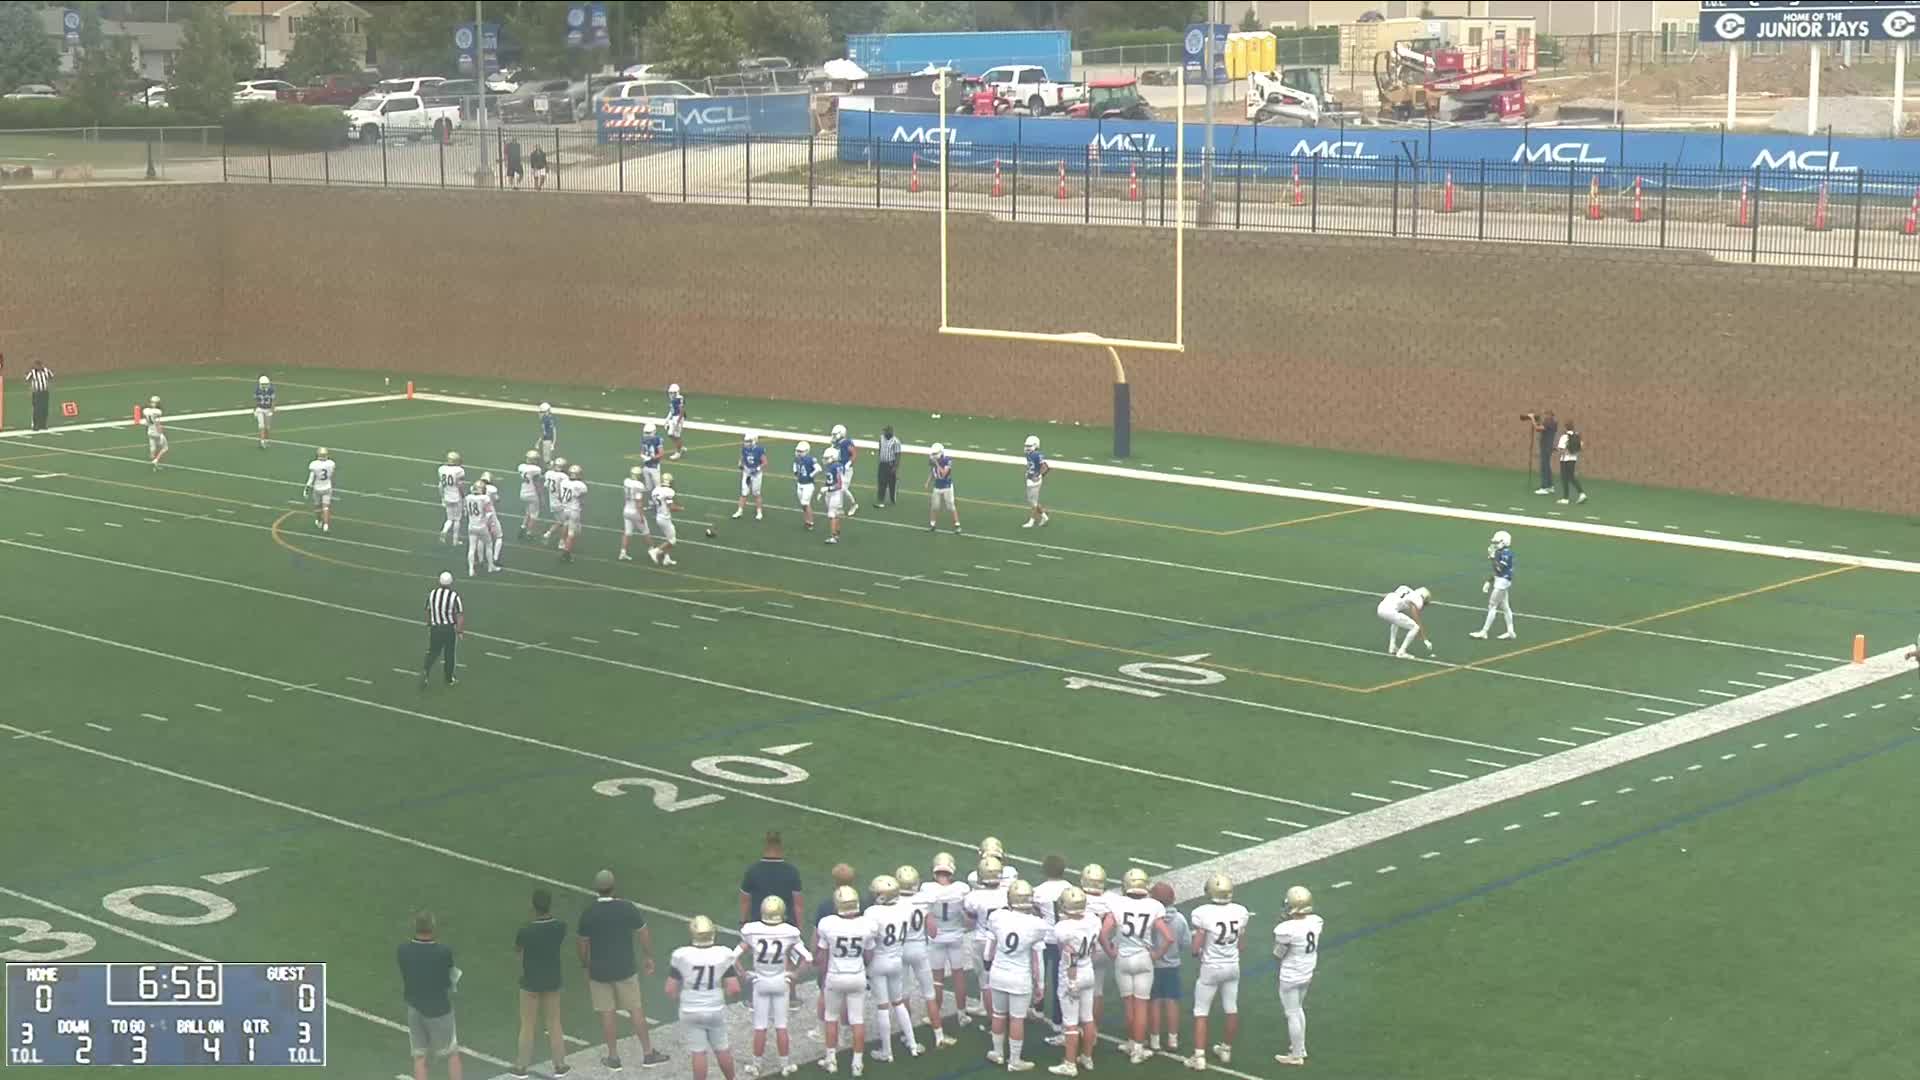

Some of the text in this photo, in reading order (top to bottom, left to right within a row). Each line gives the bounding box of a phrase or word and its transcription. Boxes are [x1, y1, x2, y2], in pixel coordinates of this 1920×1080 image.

[1783, 12, 1842, 22] HOME OF THE
[1756, 20, 1870, 38] JUNIOR JAYS
[1290, 139, 1379, 160] MCL
[1512, 142, 1607, 163] MCL
[1751, 149, 1858, 172] MCL
[320, 468, 329, 481] 3
[592, 754, 811, 813] 20
[1122, 911, 1149, 939] 57
[1216, 920, 1239, 946] 25
[756, 938, 784, 965] 22
[835, 936, 863, 959] 55
[1005, 932, 1020, 955] 9
[1305, 931, 1316, 954] 8
[692, 965, 716, 991] 71
